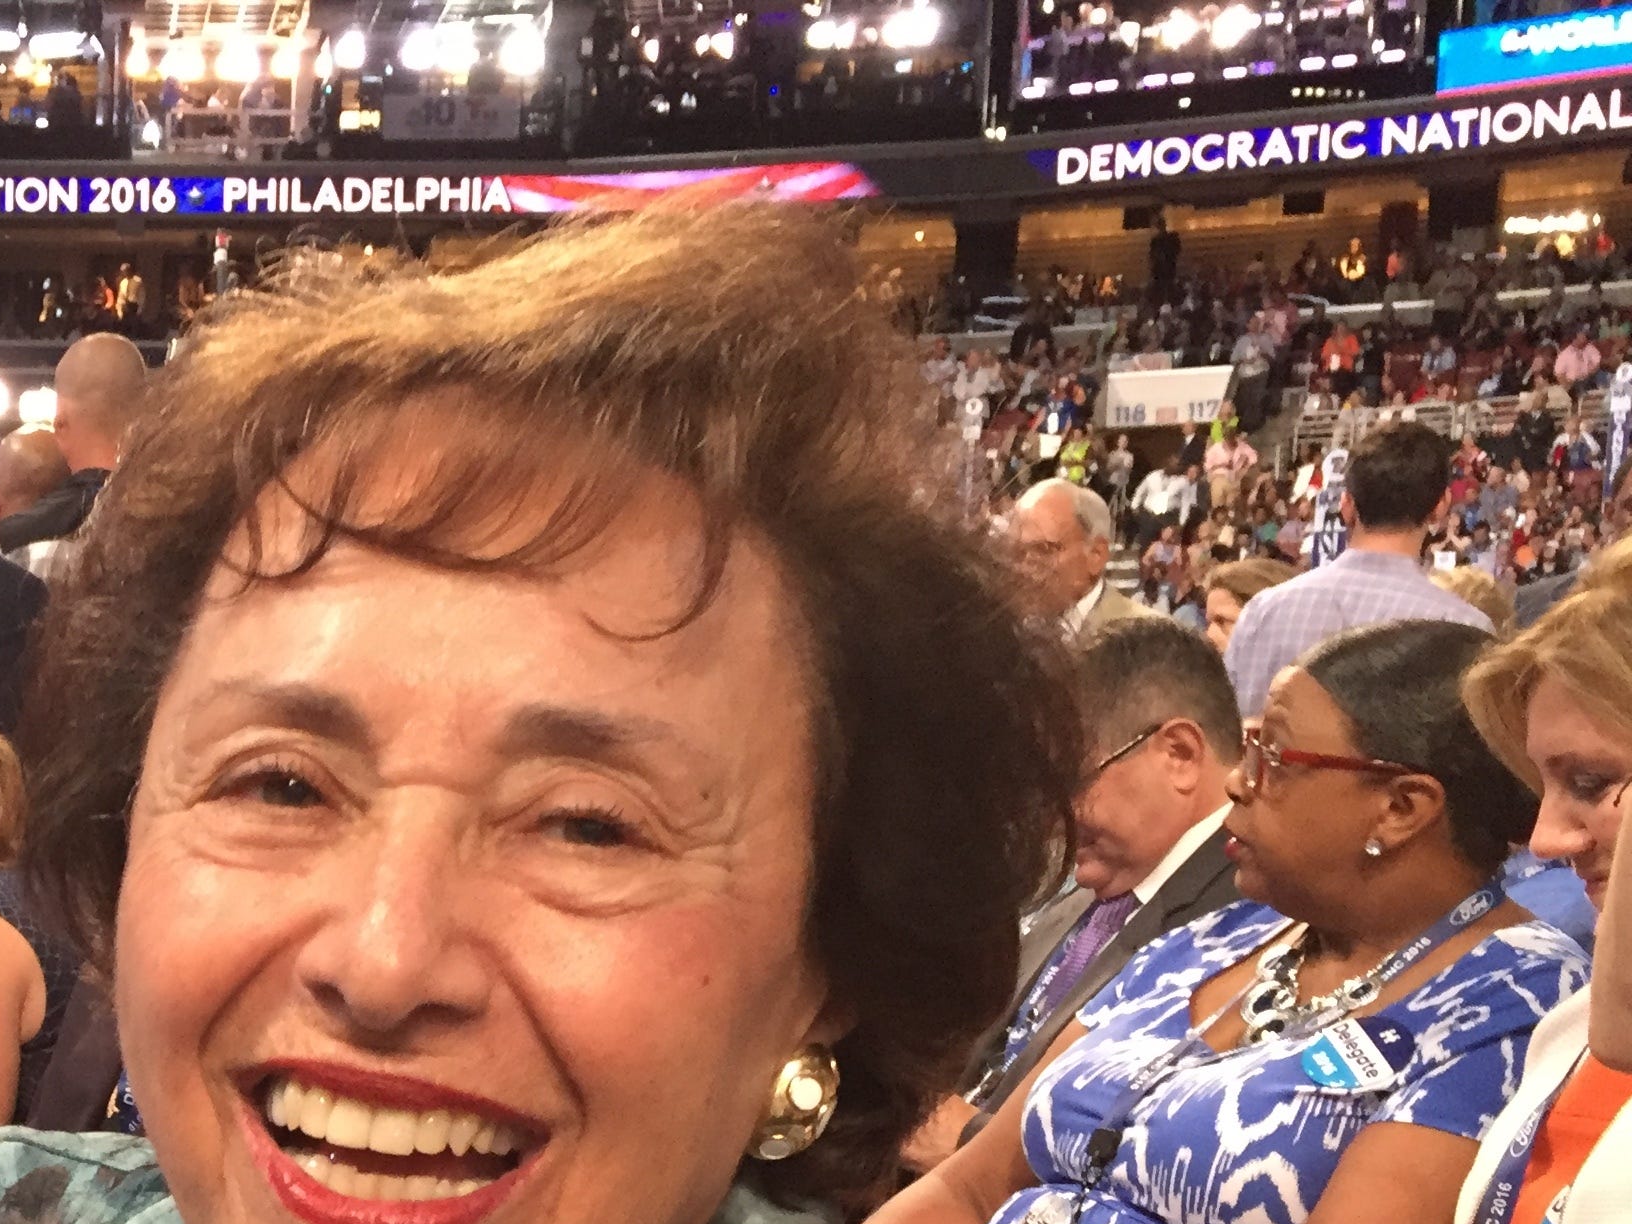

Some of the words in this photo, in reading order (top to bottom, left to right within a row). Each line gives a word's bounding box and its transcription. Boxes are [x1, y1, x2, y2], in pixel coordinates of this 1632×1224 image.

[1056, 119, 1367, 186] DEMOCRATIC
[1381, 88, 1632, 156] NATIONAL
[88, 176, 177, 214] 2016
[223, 176, 512, 213] PHILADELPHIA
[1333, 1022, 1379, 1079] Delegate
[1490, 1182, 1513, 1217] 2016
